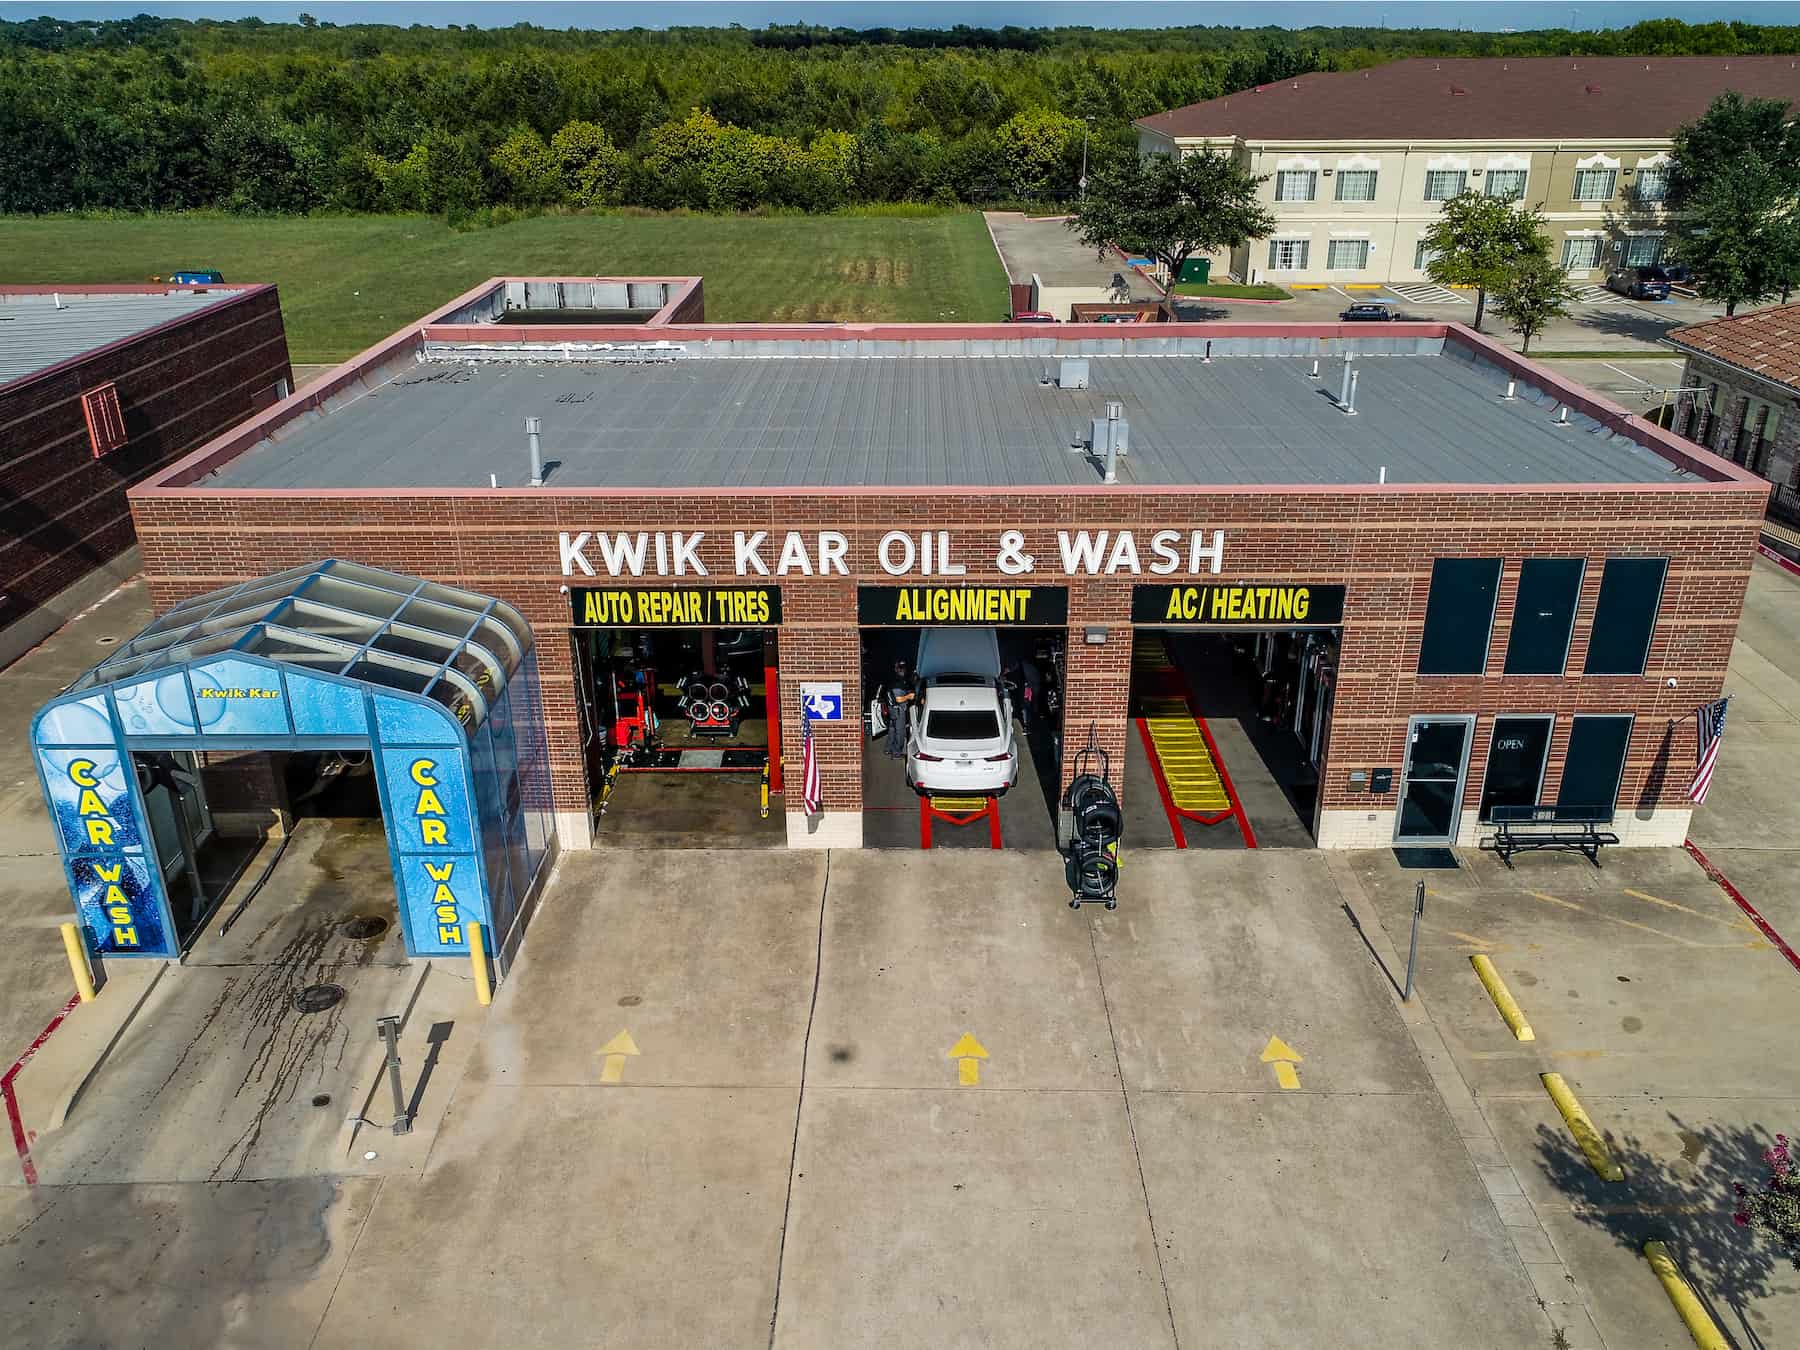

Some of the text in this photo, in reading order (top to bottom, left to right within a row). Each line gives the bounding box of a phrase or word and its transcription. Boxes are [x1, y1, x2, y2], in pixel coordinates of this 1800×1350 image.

[558, 529, 1226, 577] KWIK KAR OIL & WASH
[584, 591, 633, 623] AUTO
[637, 591, 703, 623] REPAIR
[715, 590, 770, 623] TIRES
[895, 588, 1032, 621] ALIGNMENT
[1211, 587, 1311, 620] HEATING
[201, 687, 279, 698] Kwik Kar
[1497, 739, 1525, 750] OPEN
[69, 760, 137, 946] CAR WASH
[411, 759, 462, 943] CAR WASH
